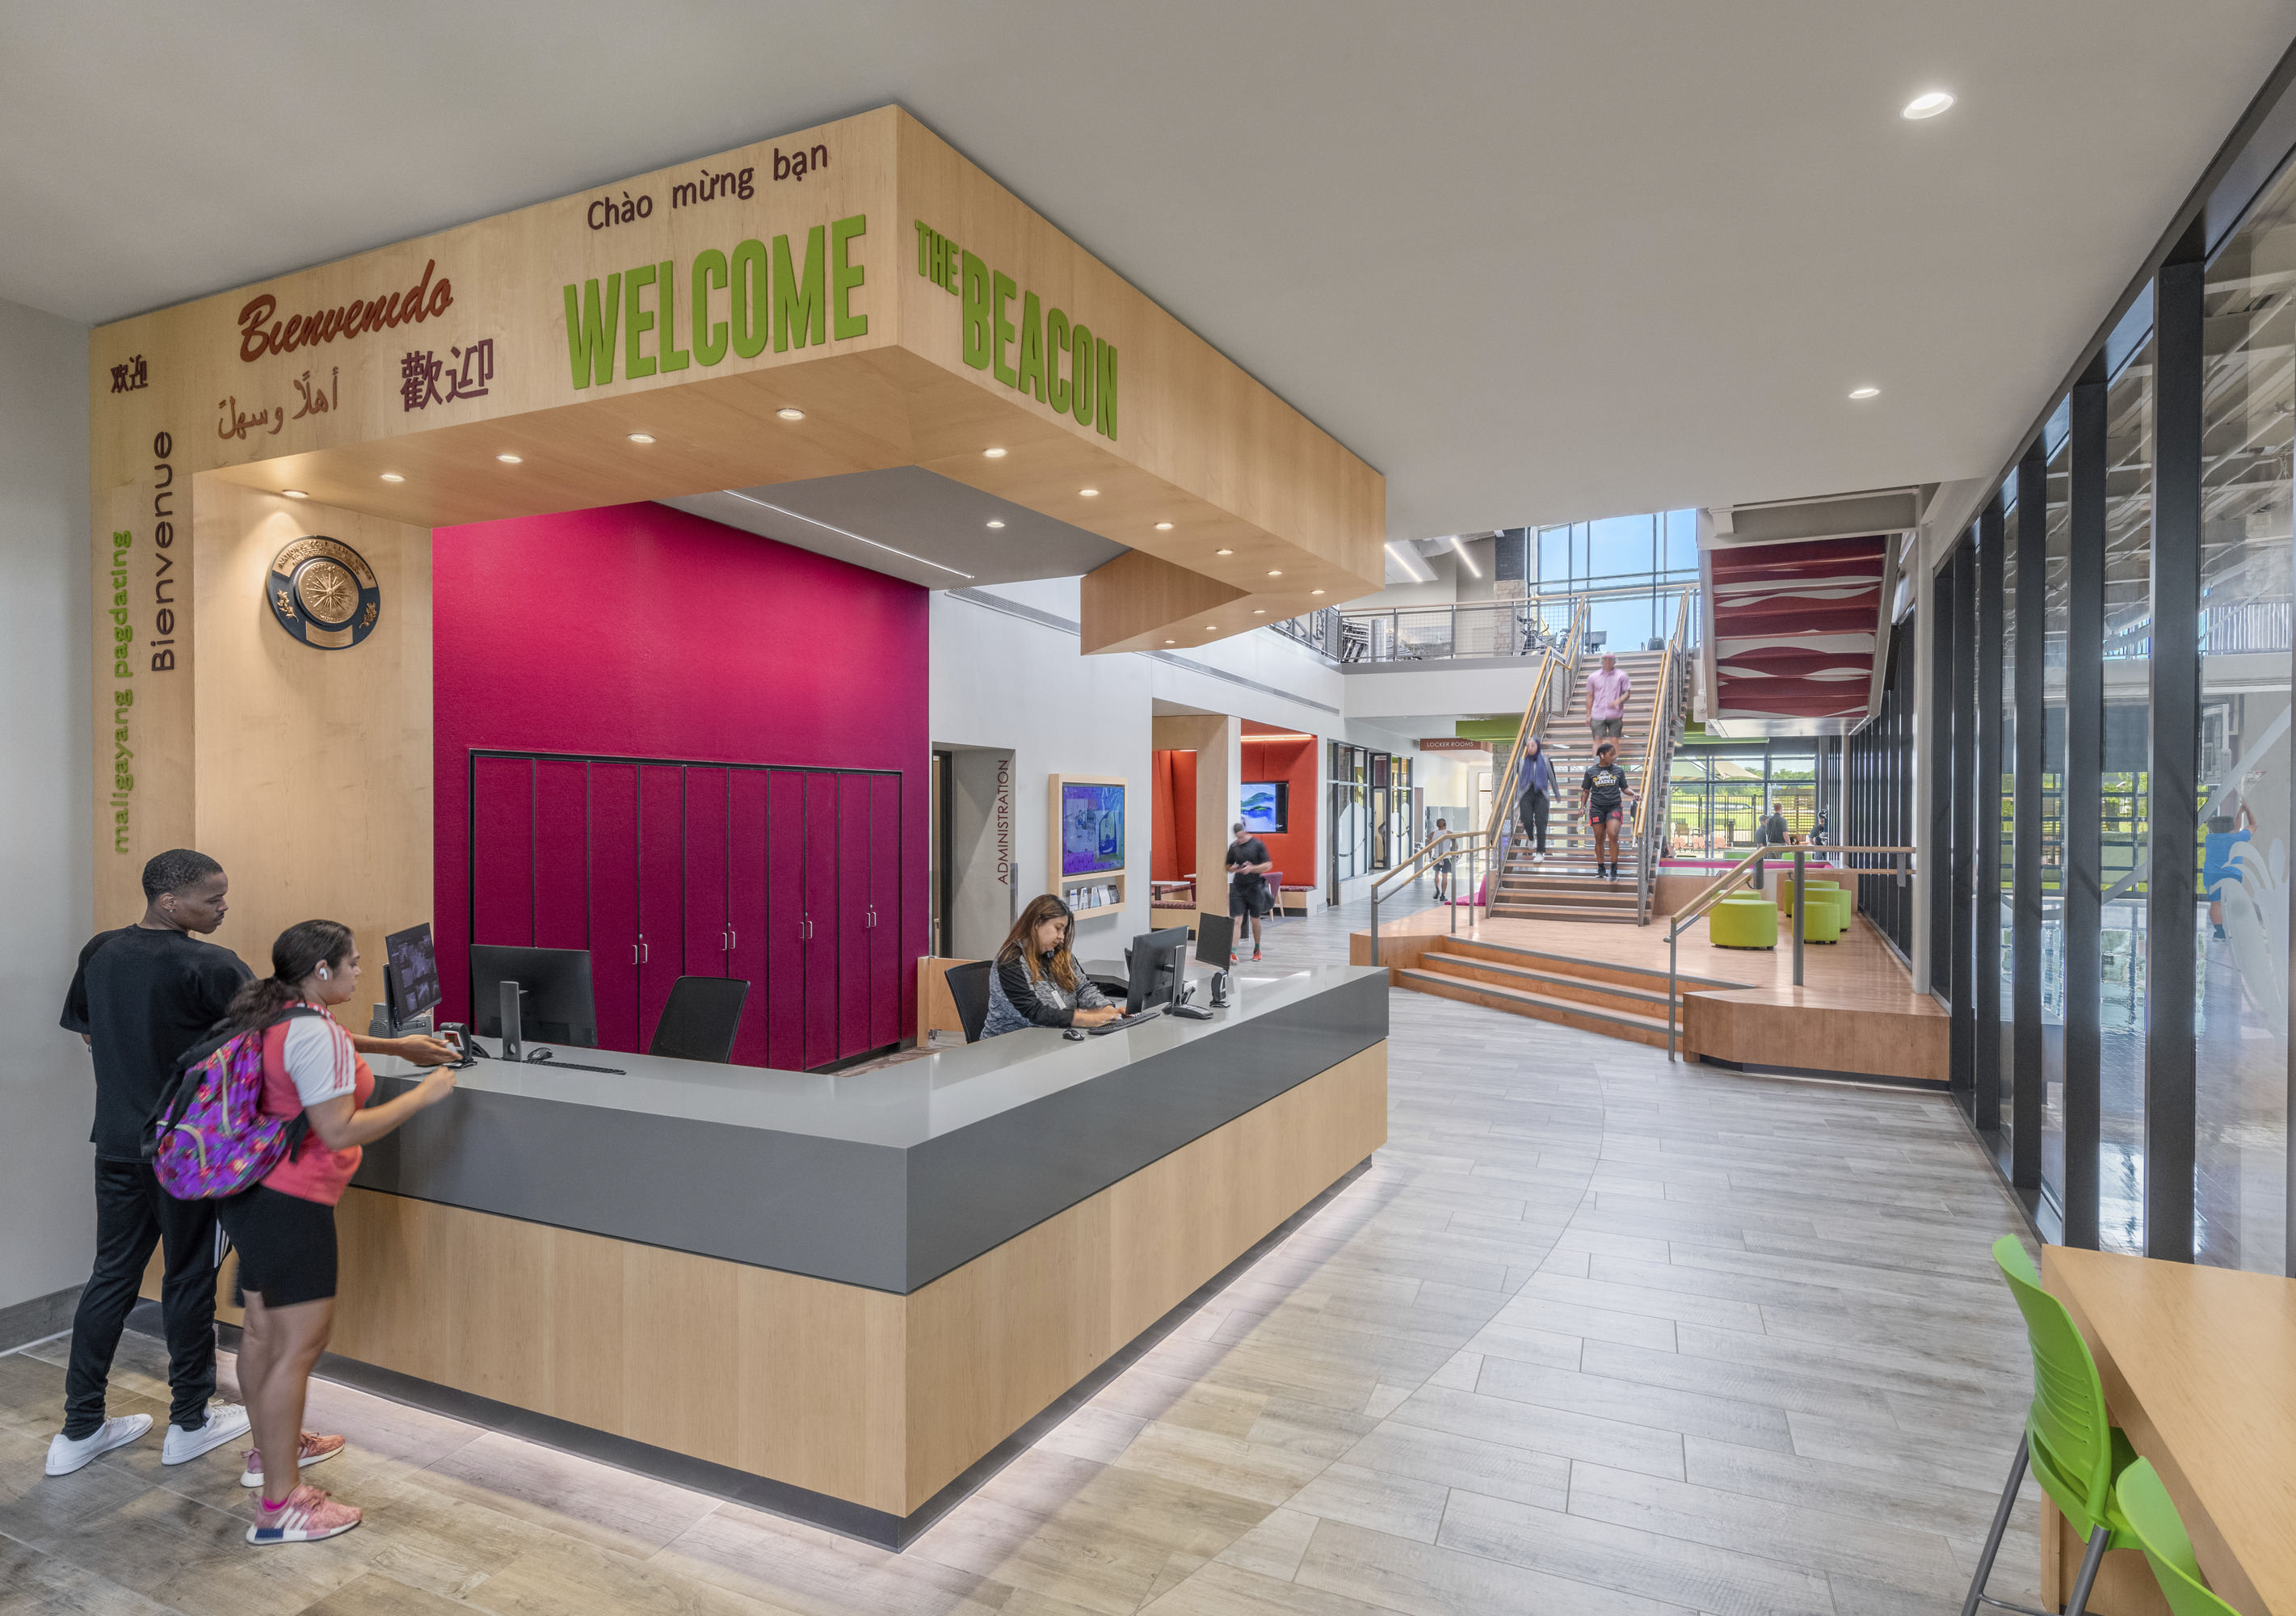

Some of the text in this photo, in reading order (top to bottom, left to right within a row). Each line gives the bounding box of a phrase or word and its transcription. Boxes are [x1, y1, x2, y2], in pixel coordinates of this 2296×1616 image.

[587, 142, 828, 231] Chào mừng bạn
[238, 259, 454, 363] Bienvenido
[563, 213, 868, 390] WELCOME
[915, 219, 960, 297] THE
[110, 353, 149, 393] 欢迎
[399, 338, 494, 413] 歡迎
[962, 249, 1118, 442] BEACON
[150, 430, 176, 673] Bienvenue
[108, 529, 134, 854] maligayang pagdating
[997, 760, 1009, 886] ADMINISTRATION
